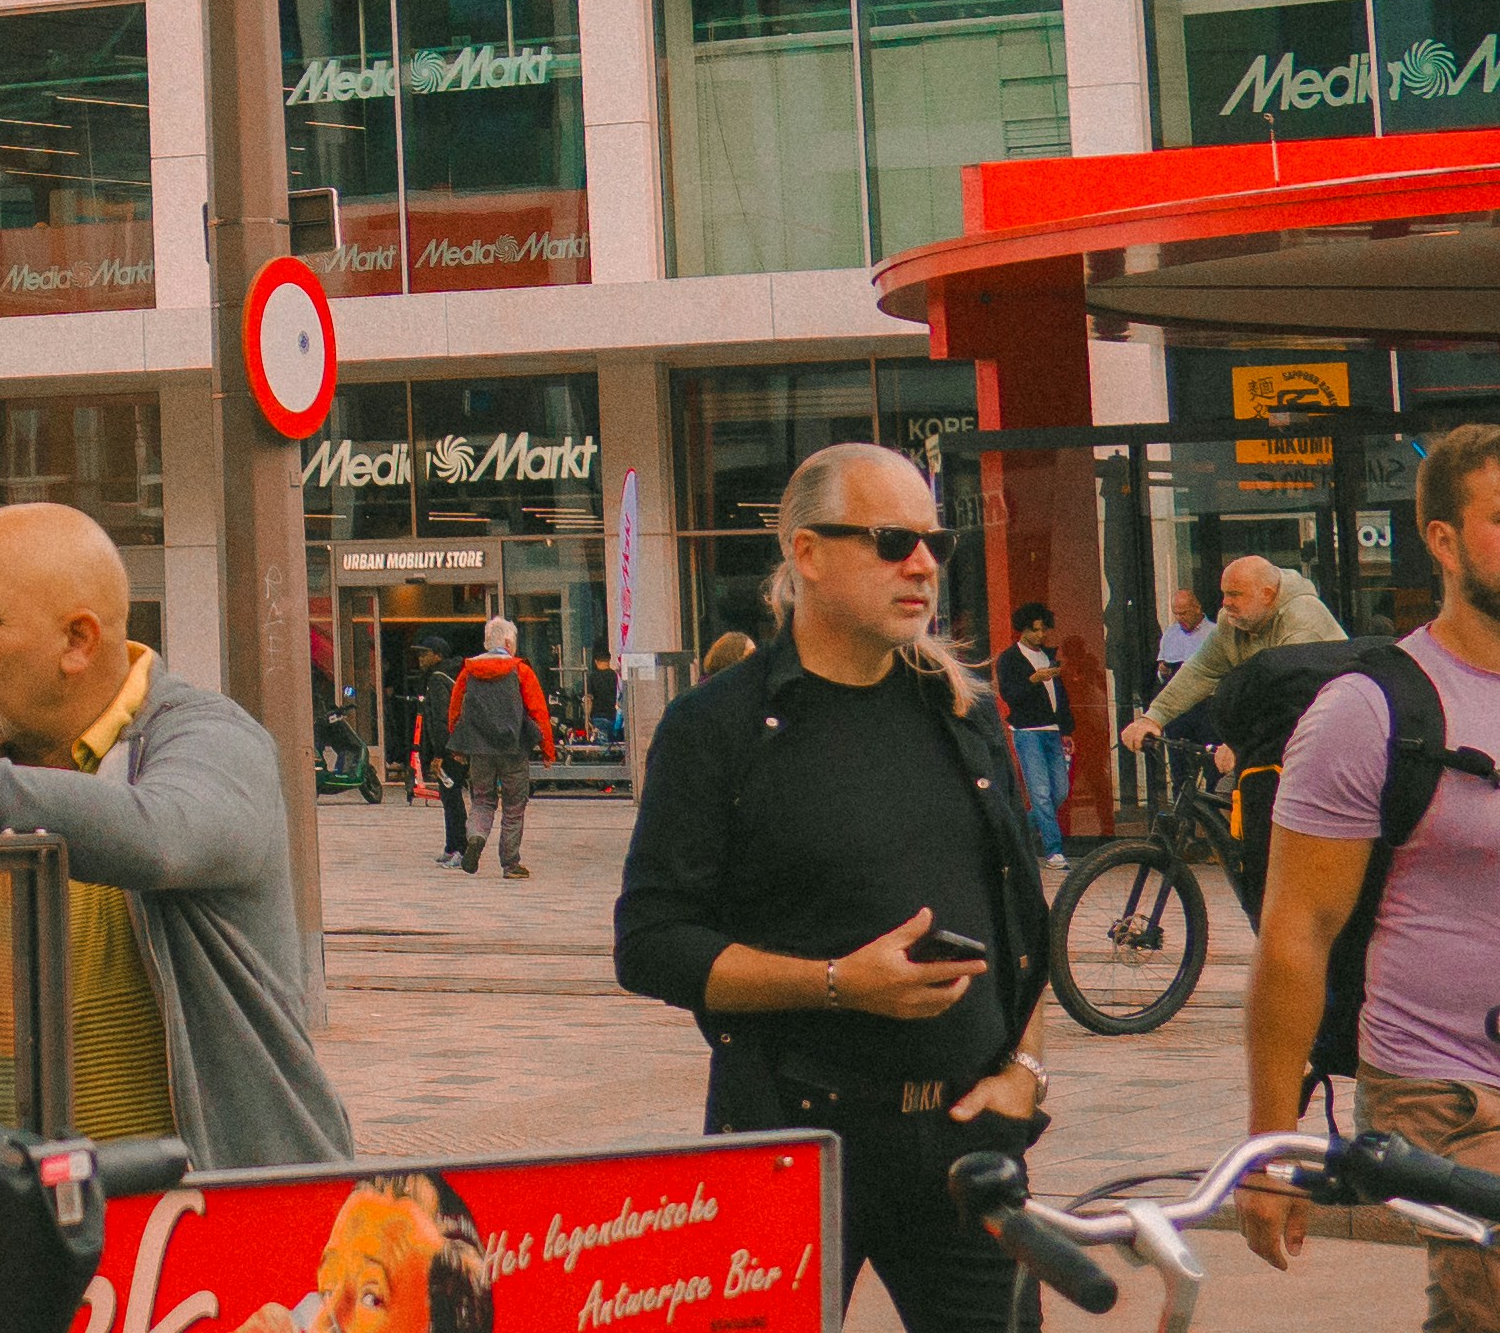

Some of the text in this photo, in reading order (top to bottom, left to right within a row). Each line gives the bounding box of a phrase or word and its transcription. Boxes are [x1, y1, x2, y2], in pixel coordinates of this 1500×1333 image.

[438, 44, 552, 92] Markt
[323, 243, 397, 274] Markt
[414, 231, 589, 269] Media Markt
[468, 431, 598, 482] Markt
[342, 550, 485, 570] URBAN MOBILITY STORE
[480, 1181, 719, 1284] Het legendarische
[577, 1279, 713, 1332] Antwerpse
[723, 1248, 782, 1299] Bier
